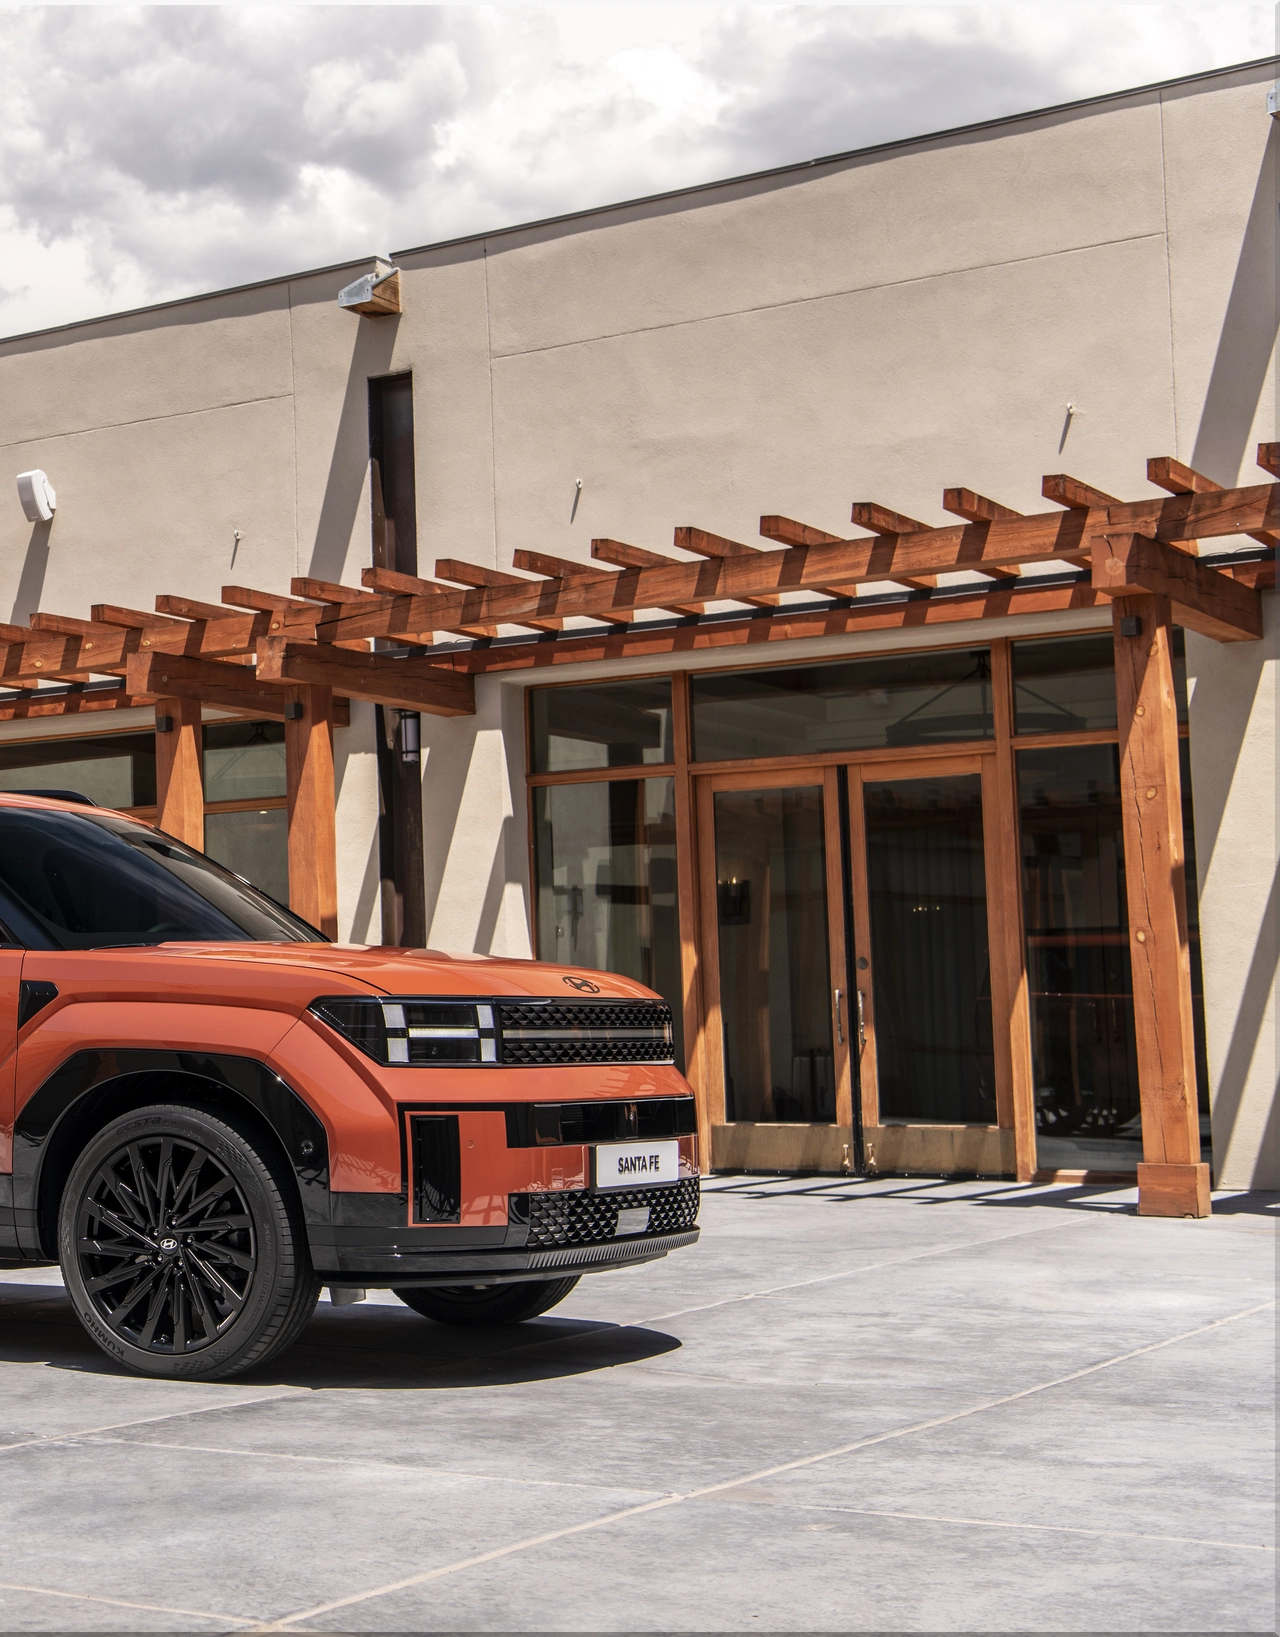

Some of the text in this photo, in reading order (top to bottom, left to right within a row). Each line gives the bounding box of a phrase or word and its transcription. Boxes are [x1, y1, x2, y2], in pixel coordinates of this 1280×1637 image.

[618, 1155, 660, 1174] SANTA FE
[83, 1312, 125, 1358] KUMHO
